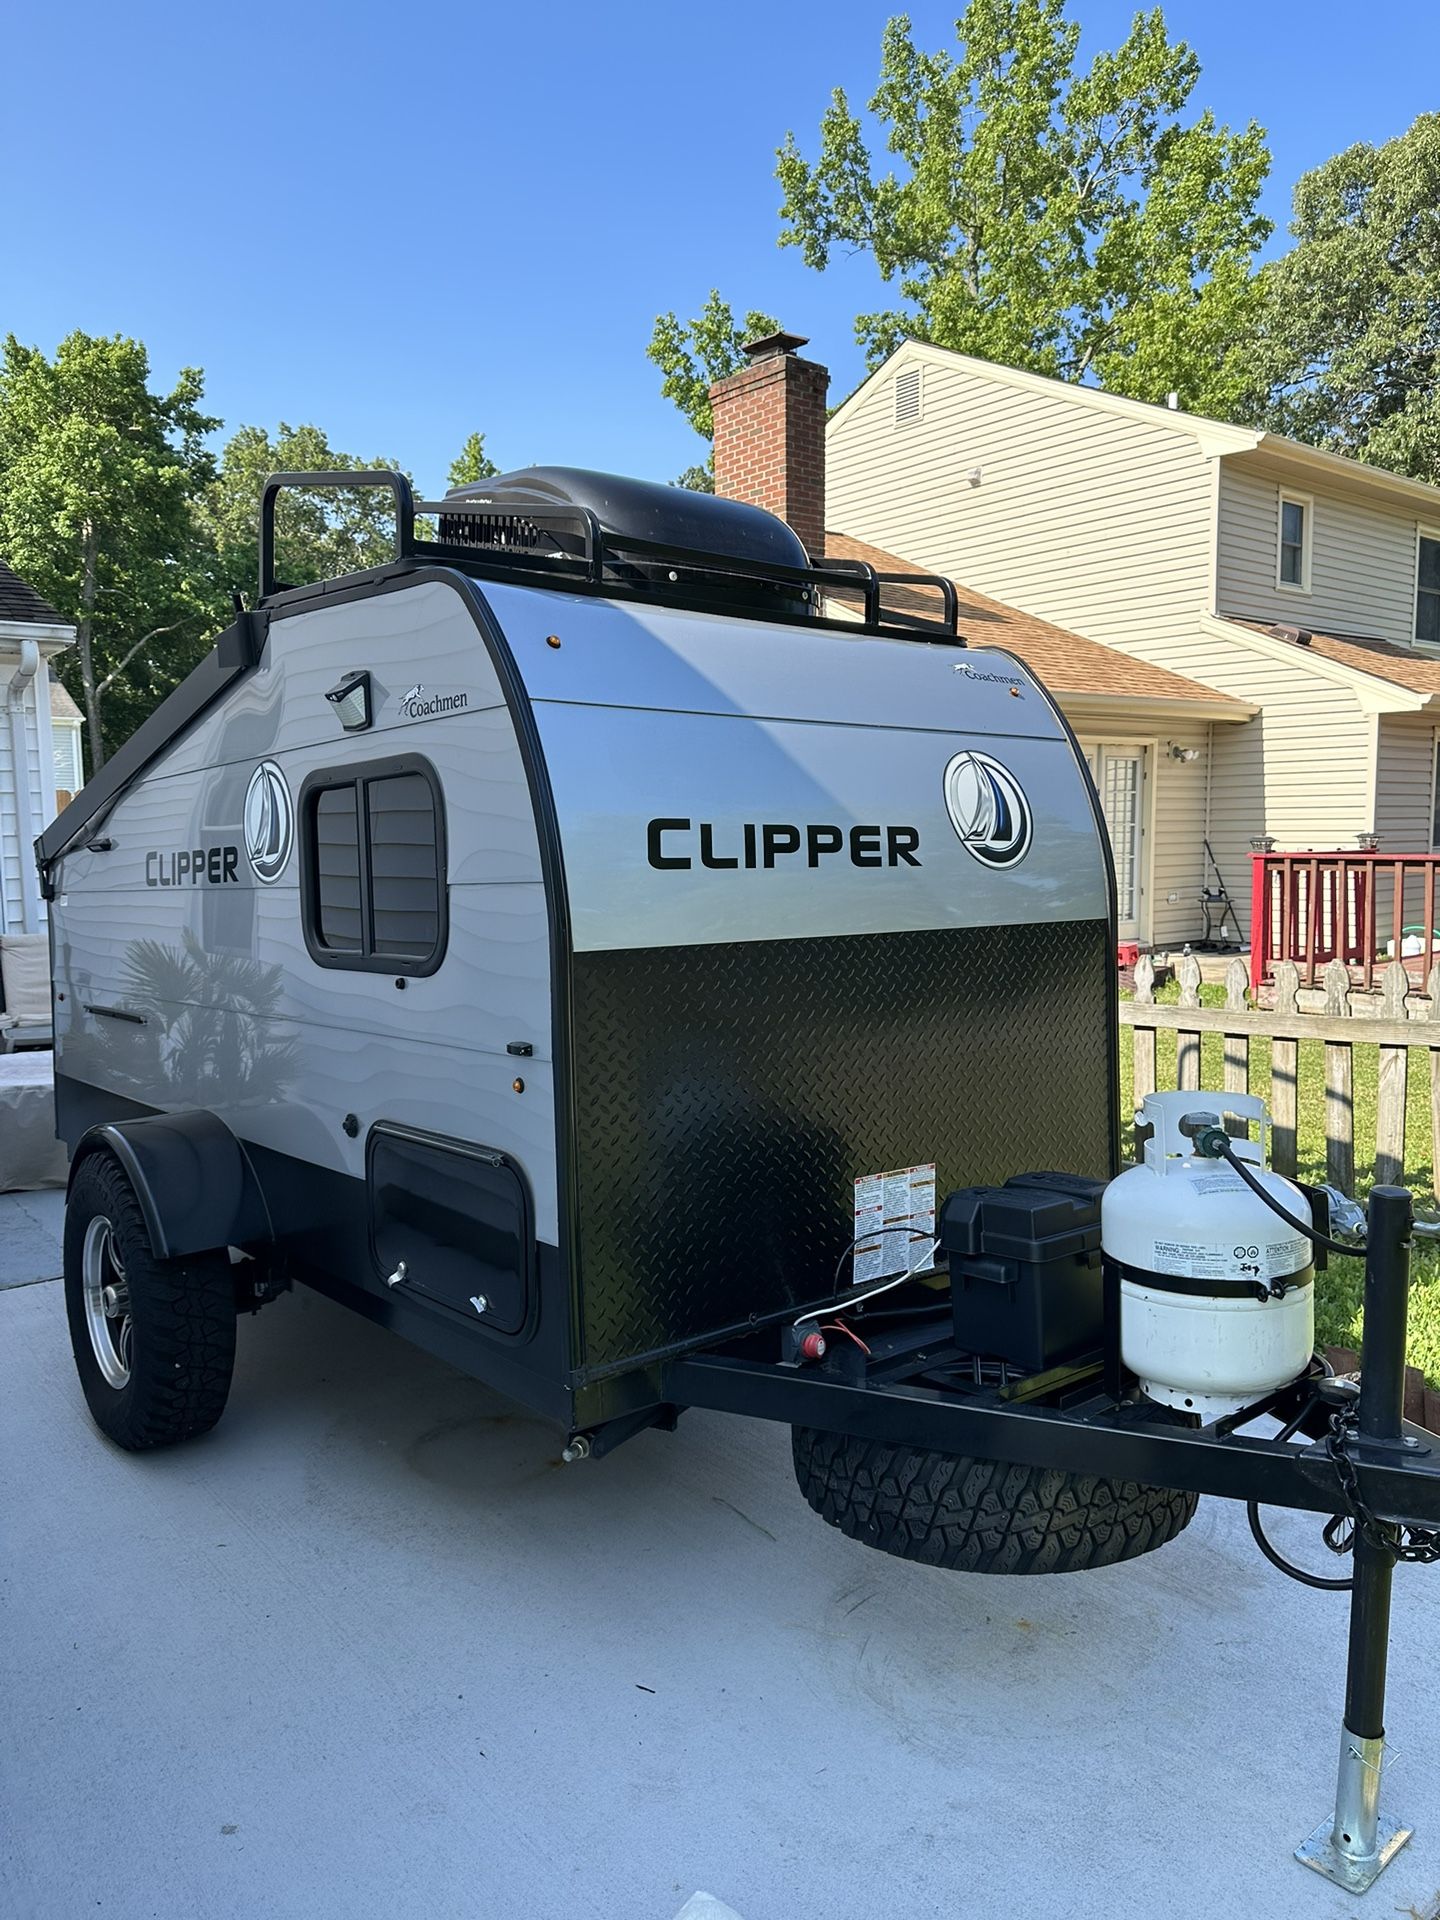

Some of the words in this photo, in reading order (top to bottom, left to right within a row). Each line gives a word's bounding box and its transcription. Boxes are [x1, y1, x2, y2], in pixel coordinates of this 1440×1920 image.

[965, 670, 1026, 686] Coachmen
[409, 692, 468, 719] Coachmen
[647, 817, 923, 870] CLIPPER
[146, 846, 239, 887] CLIPPER
